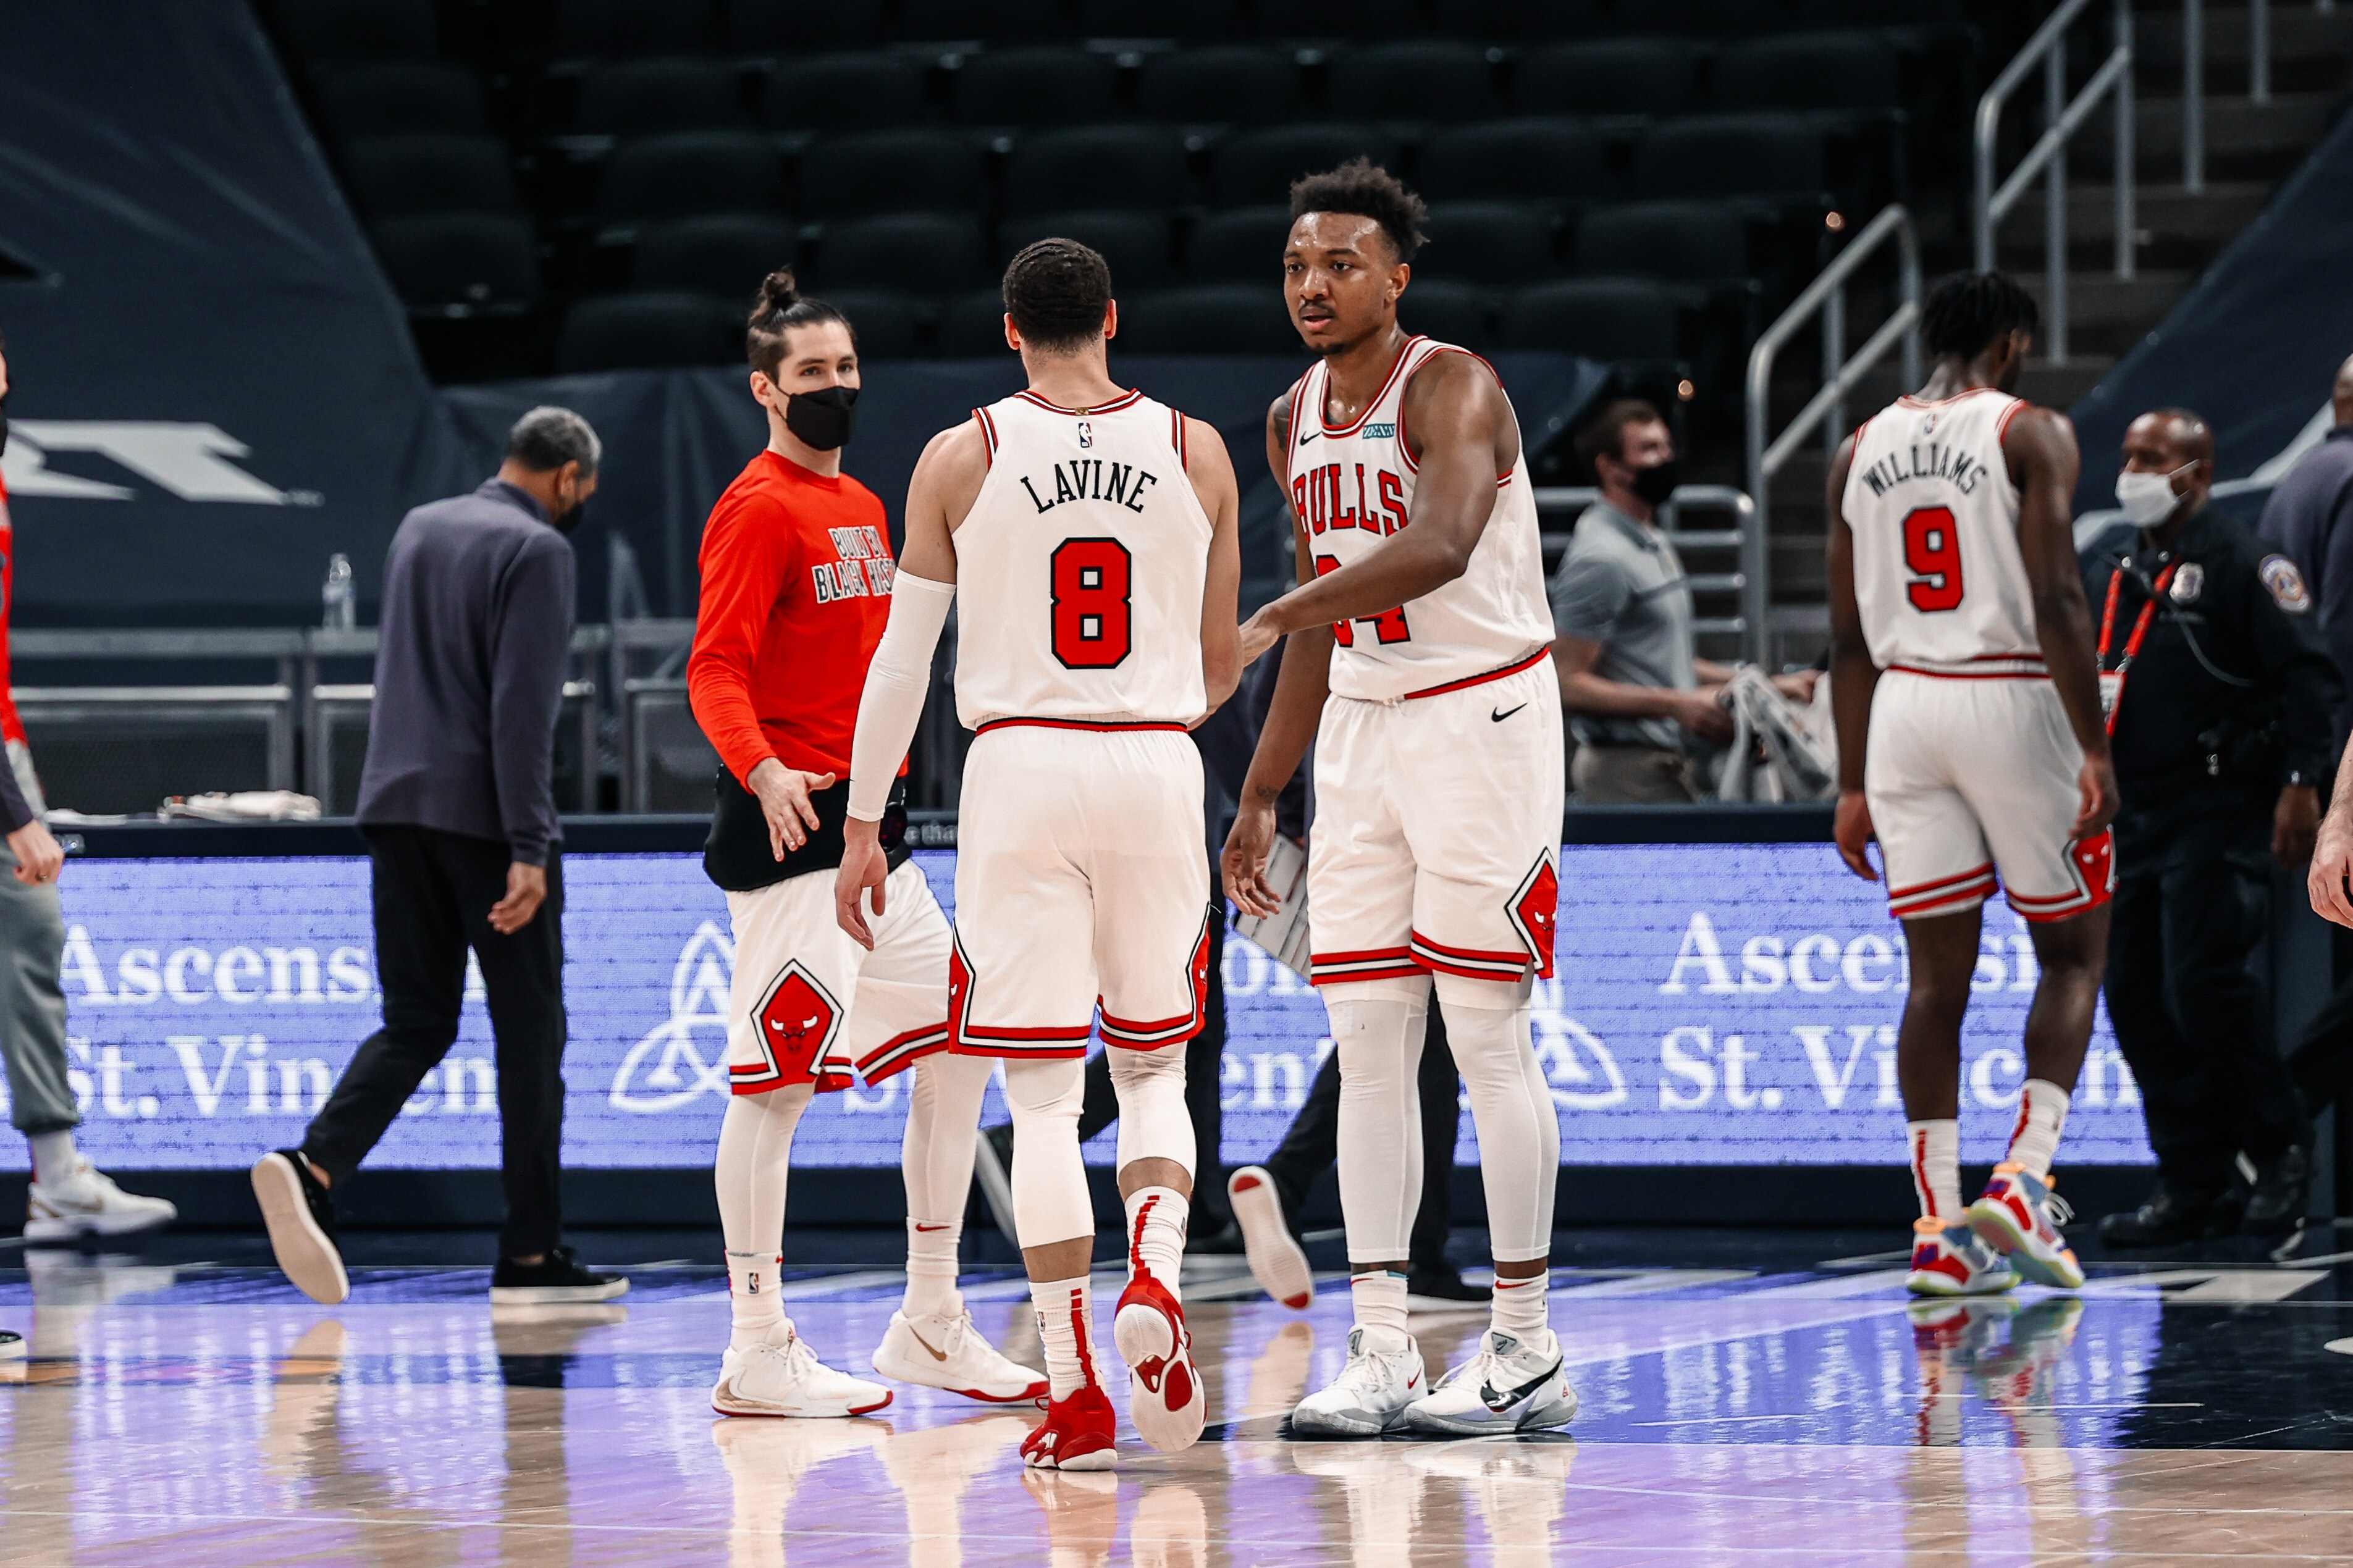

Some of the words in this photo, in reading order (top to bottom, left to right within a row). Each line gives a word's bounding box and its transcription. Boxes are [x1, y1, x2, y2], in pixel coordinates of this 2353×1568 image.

[1020, 459, 1158, 514] LAVINE
[1292, 463, 1409, 543] BULLS
[1861, 442, 1987, 497] WILLIAMS
[811, 559, 869, 604] BLACK
[1900, 505, 1964, 613] 9
[1050, 537, 1132, 670] 8
[1659, 1025, 1784, 1110] St.
